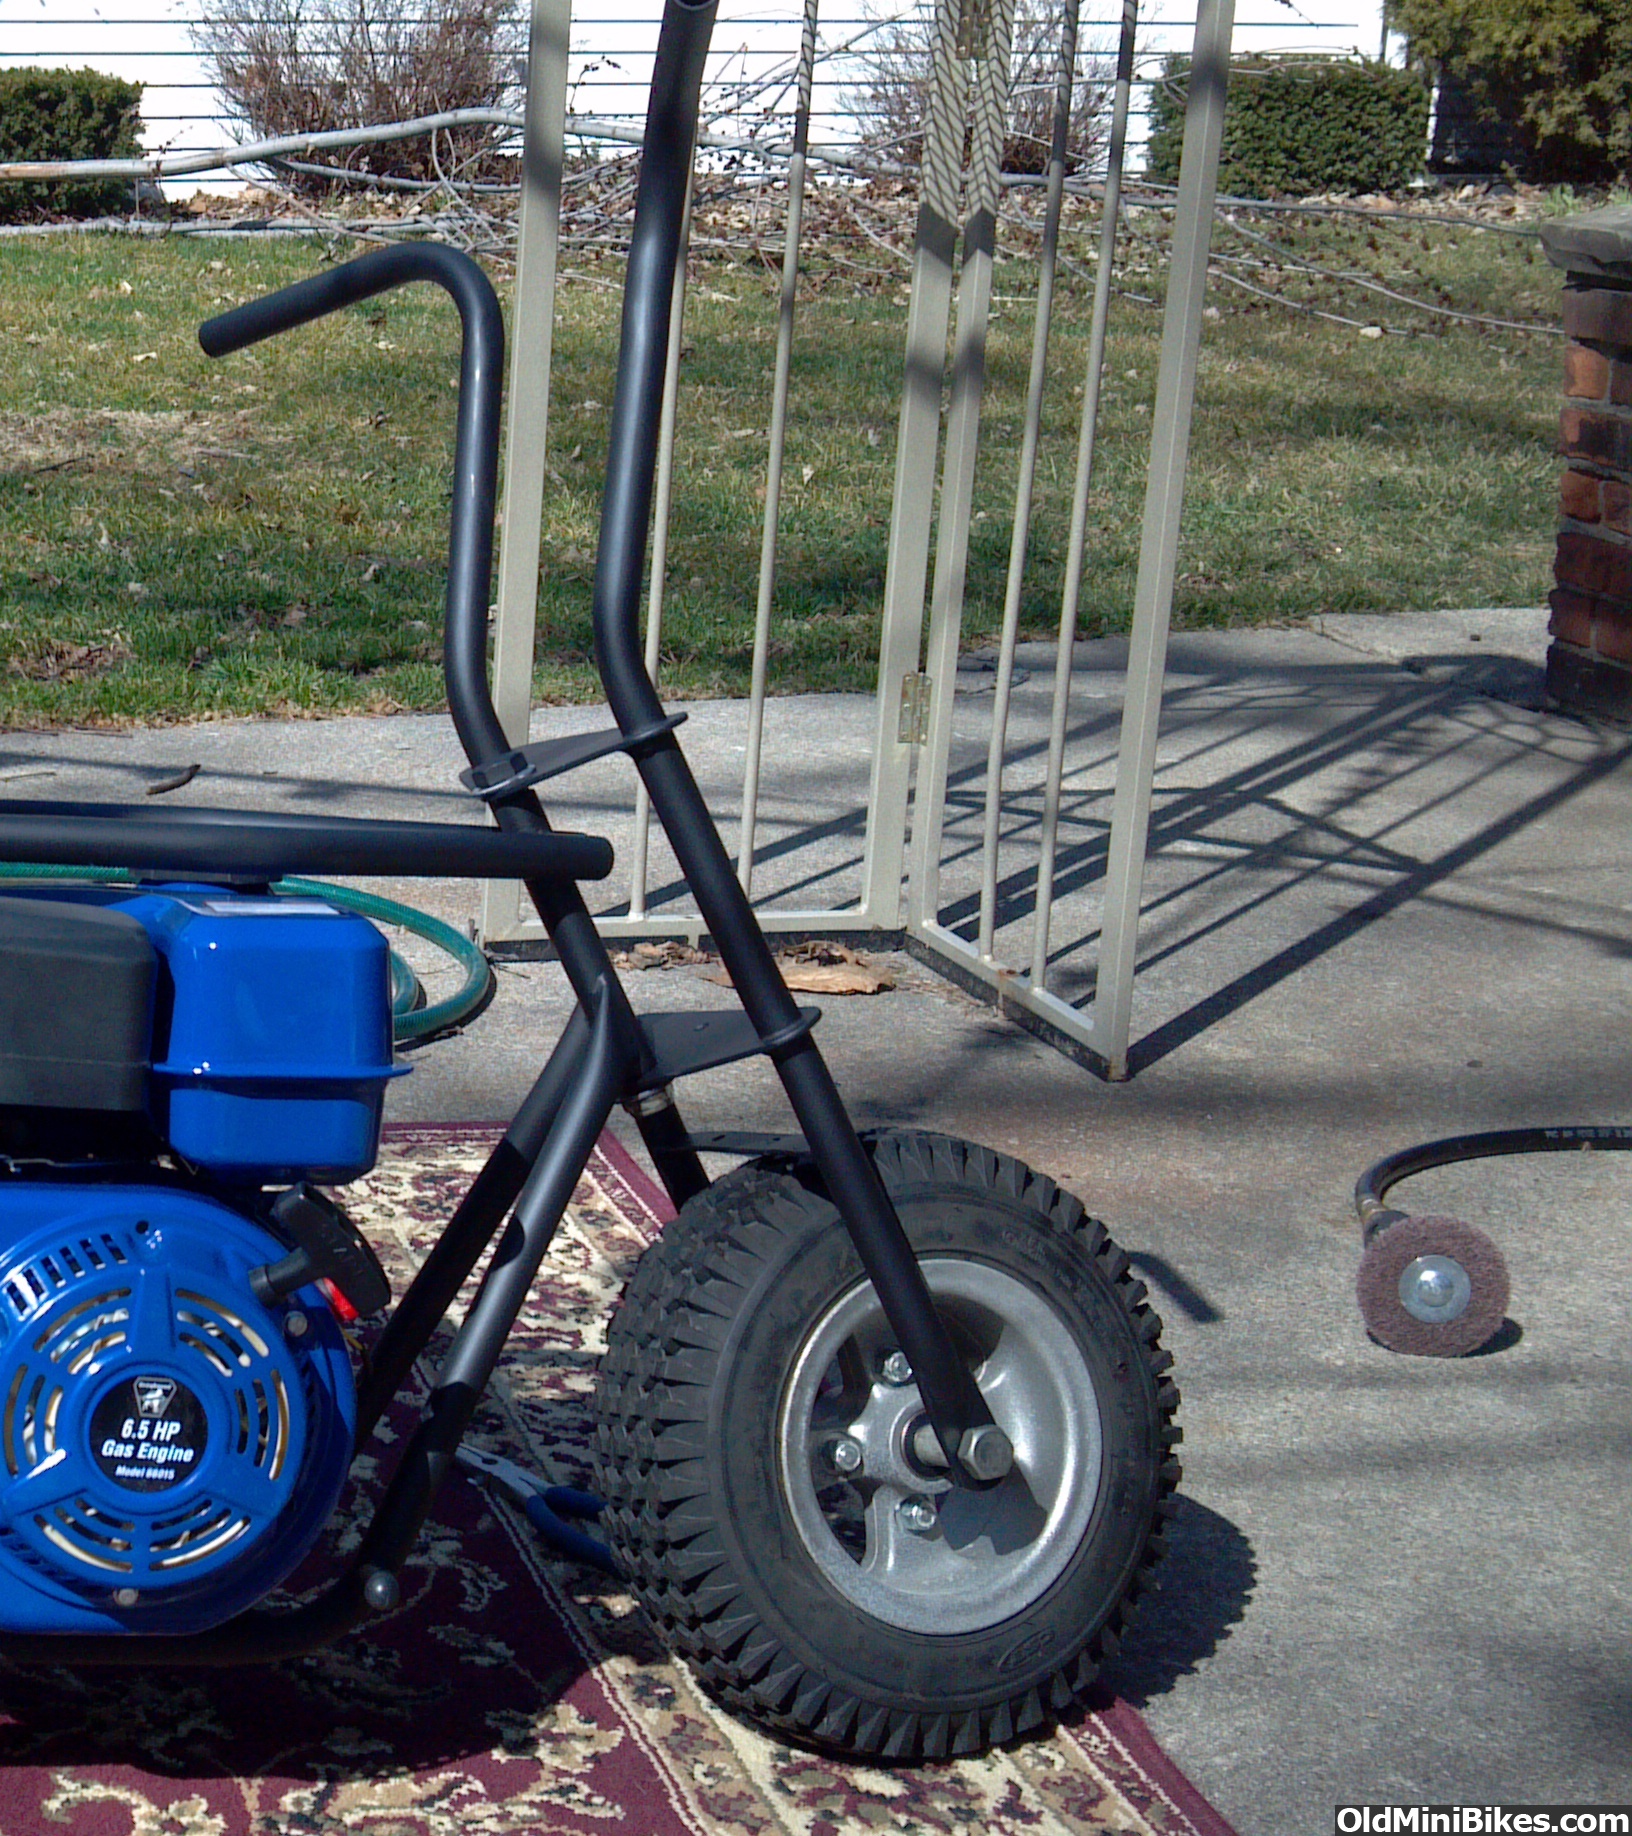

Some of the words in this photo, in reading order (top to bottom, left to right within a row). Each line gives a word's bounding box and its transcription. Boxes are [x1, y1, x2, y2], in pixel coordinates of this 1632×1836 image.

[121, 1418, 150, 1440] 6.5
[152, 1420, 181, 1442] HP
[101, 1439, 135, 1459] Gas
[136, 1442, 195, 1464] Engine
[115, 1465, 145, 1479] Model
